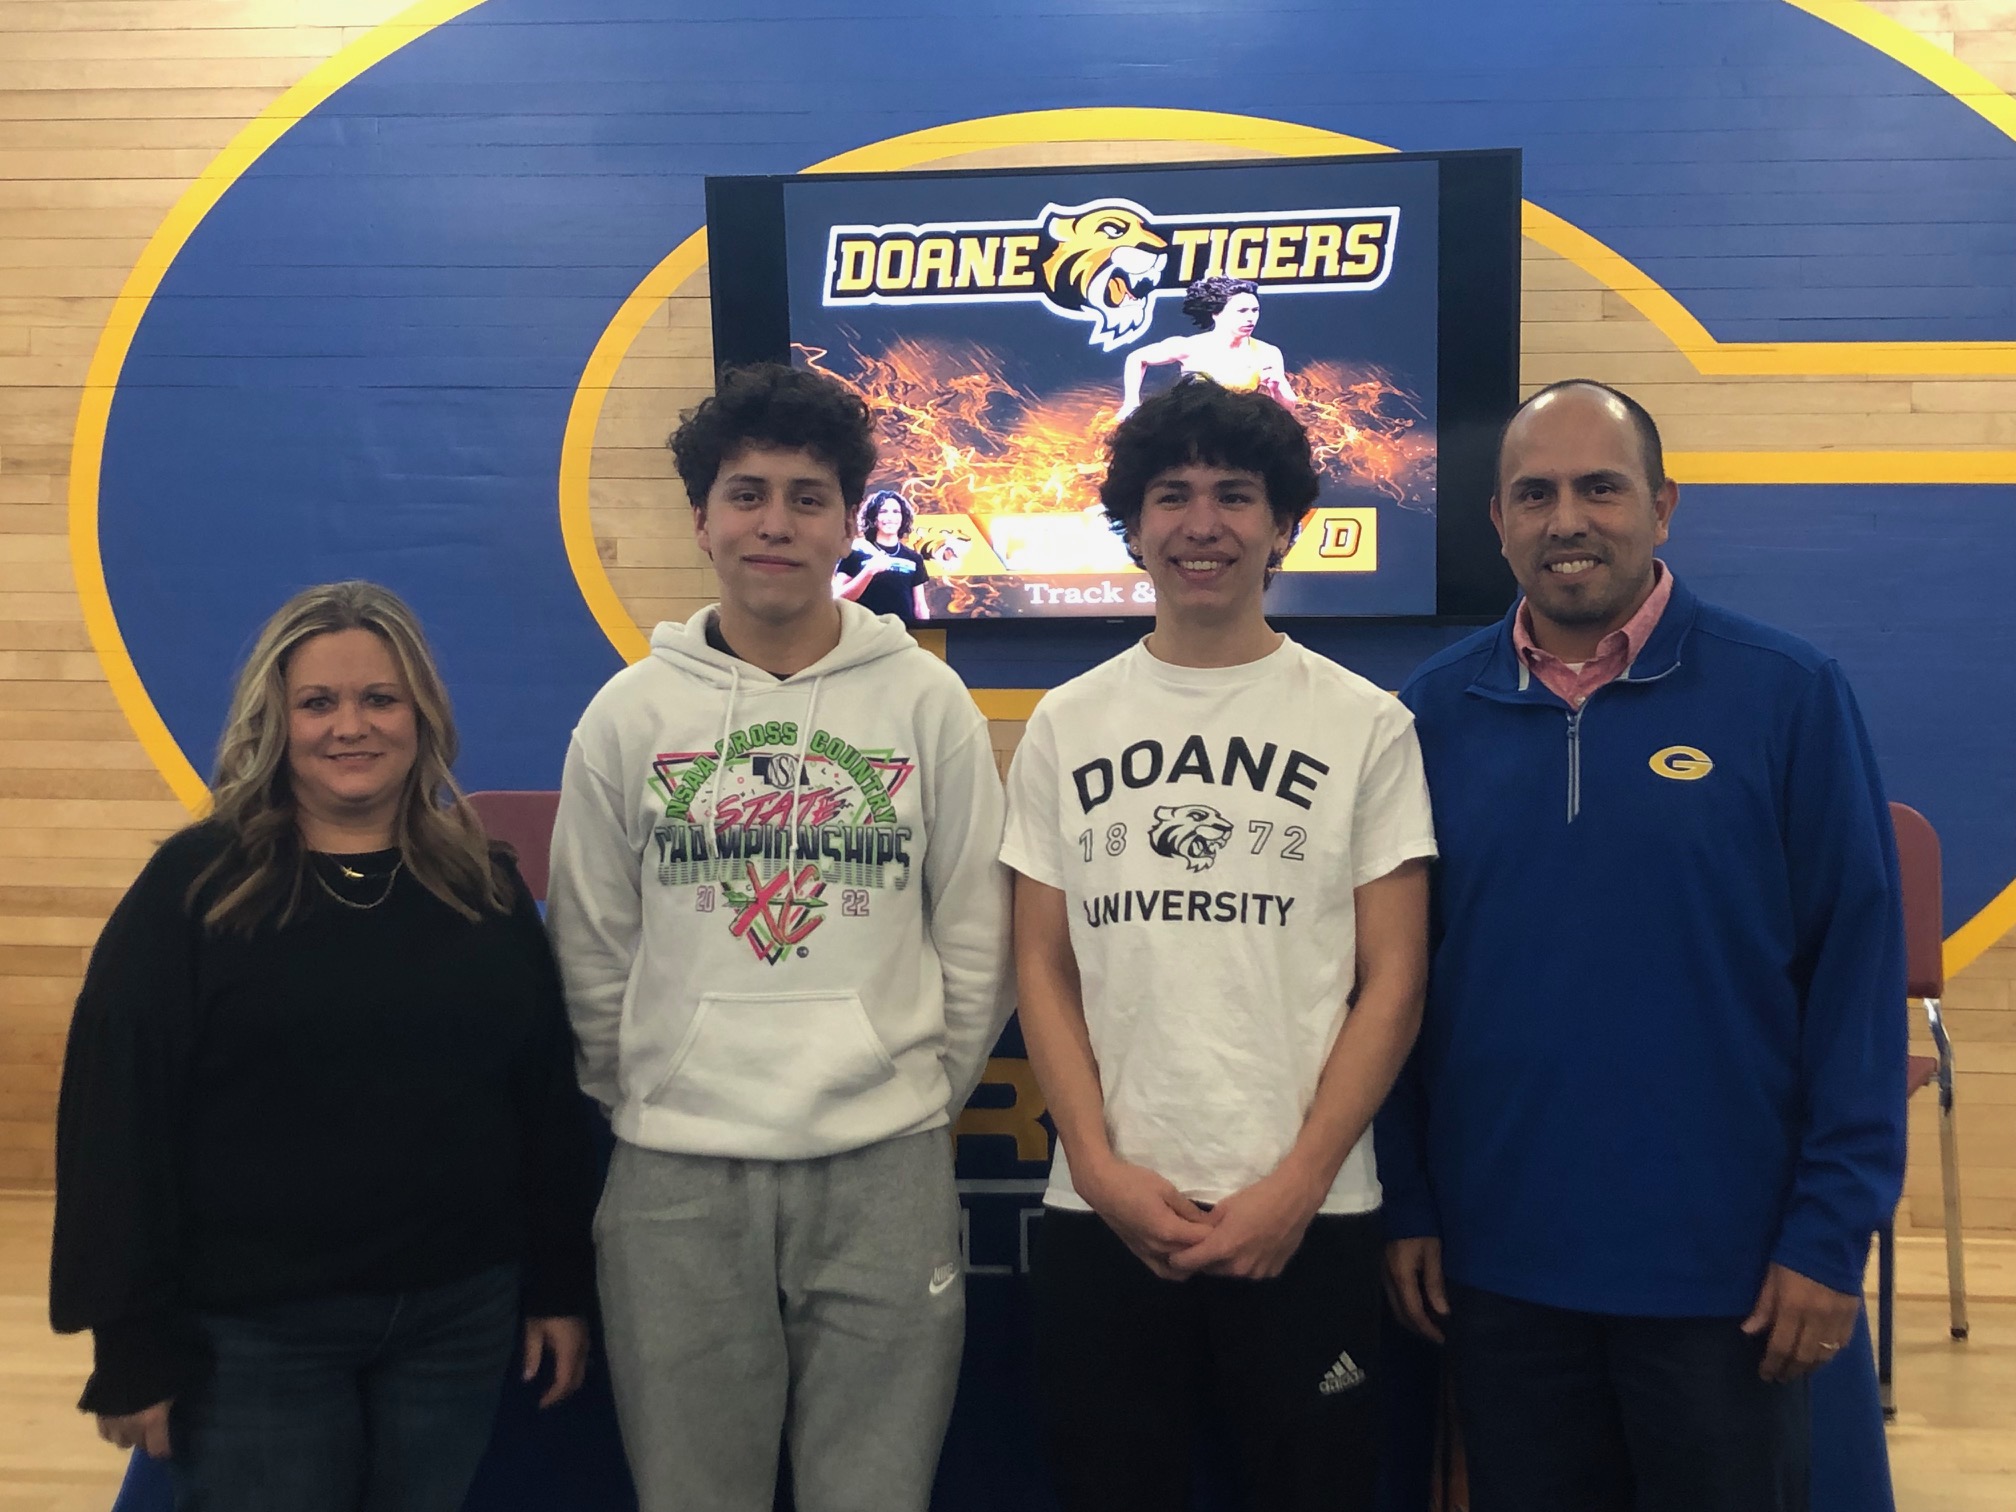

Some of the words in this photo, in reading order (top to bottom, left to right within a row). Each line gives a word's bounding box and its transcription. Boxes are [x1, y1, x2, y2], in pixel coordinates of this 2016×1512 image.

[836, 234, 1041, 291] DOANE
[1171, 222, 1384, 281] TIGERS
[1318, 517, 1362, 560] D
[1025, 580, 1125, 604] Track
[1131, 581, 1157, 603] &
[665, 755, 718, 822] NSAA
[715, 721, 798, 761] CROSS
[810, 730, 897, 824] COUNTRY
[1072, 734, 1330, 815] DOANE
[1648, 745, 1714, 780] G
[715, 786, 853, 834] STATE
[695, 885, 715, 913] 20
[842, 889, 870, 917] 22
[1083, 889, 1295, 928] UNIVERSITY
